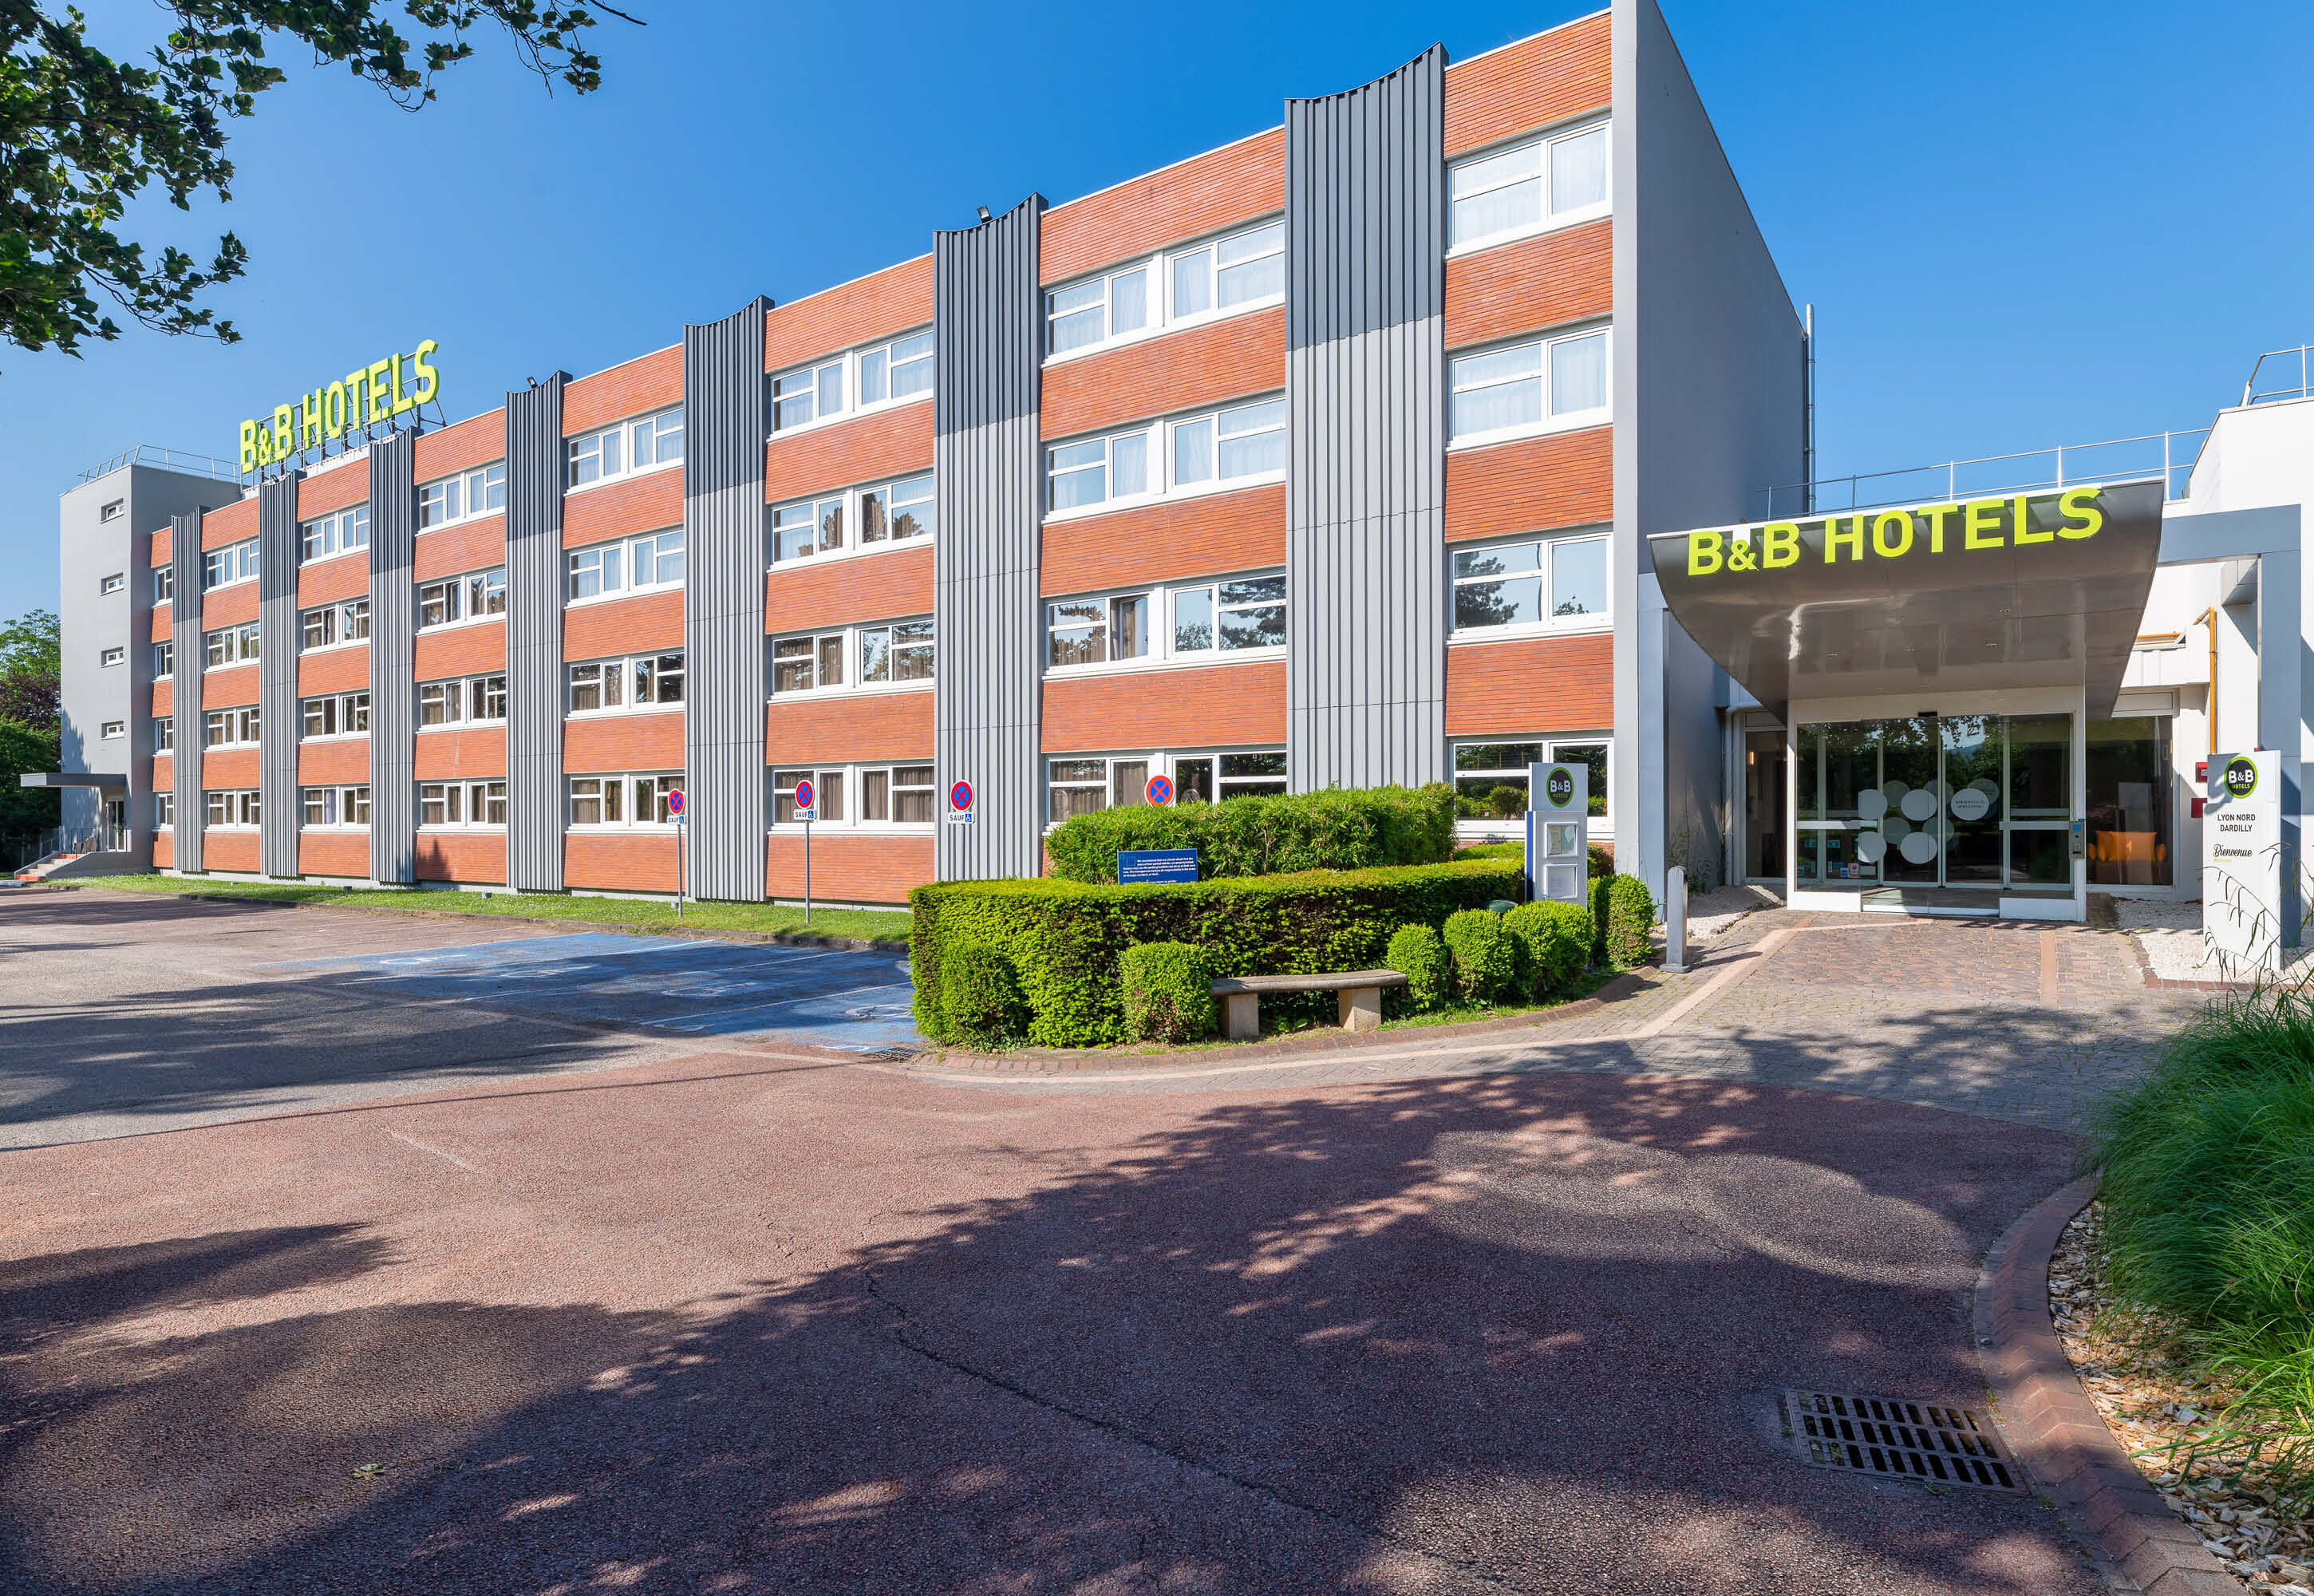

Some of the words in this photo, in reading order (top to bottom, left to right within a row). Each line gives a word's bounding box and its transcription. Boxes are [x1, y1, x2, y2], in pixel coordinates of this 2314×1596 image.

[240, 404, 295, 474] B&B
[303, 339, 440, 450] HOTELS
[1688, 522, 1800, 576] B&B
[1825, 488, 2104, 563] HOTELS
[2228, 769, 2254, 784] B&B
[1550, 780, 1571, 792] B&B
[2213, 843, 2253, 857] Bienvenue
